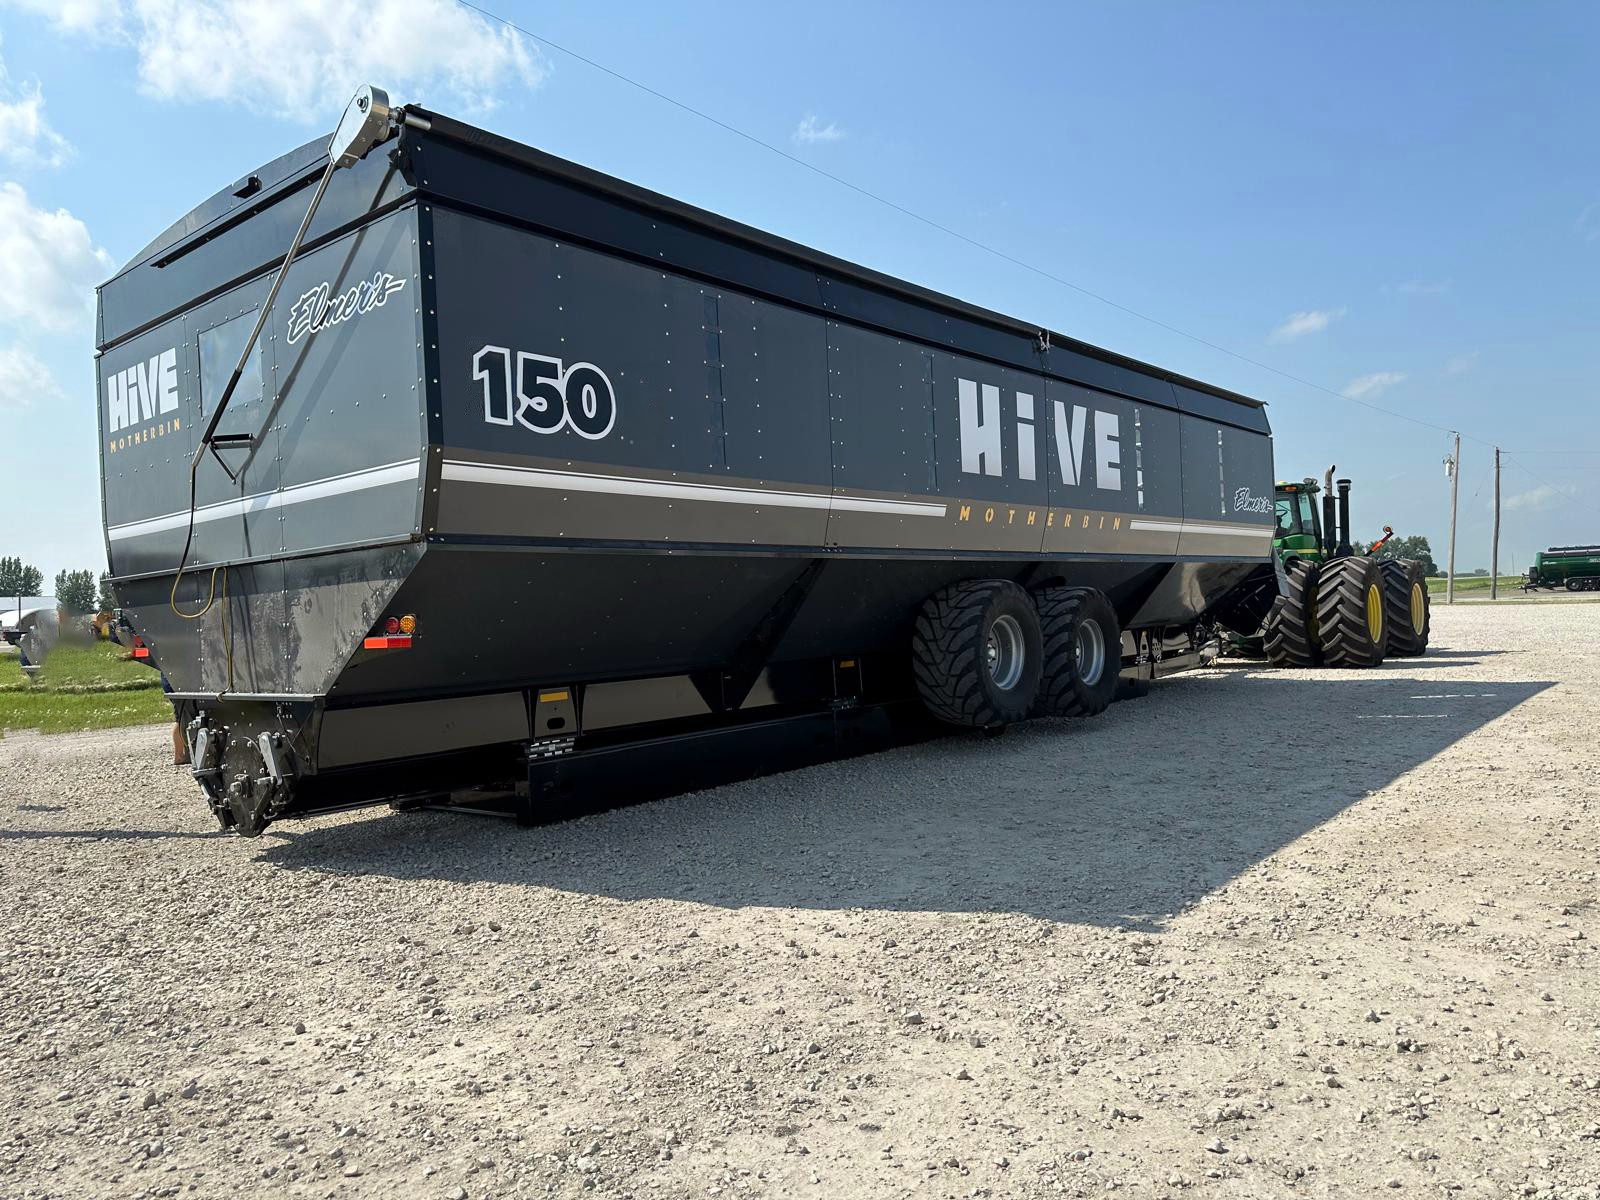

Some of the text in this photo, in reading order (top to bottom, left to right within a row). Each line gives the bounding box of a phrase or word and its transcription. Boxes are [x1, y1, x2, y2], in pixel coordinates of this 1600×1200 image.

[287, 271, 407, 344] Elmer's
[473, 344, 616, 440] 150
[110, 418, 181, 454] MOTHERBIN
[959, 505, 1122, 531] MOTHERBIN
